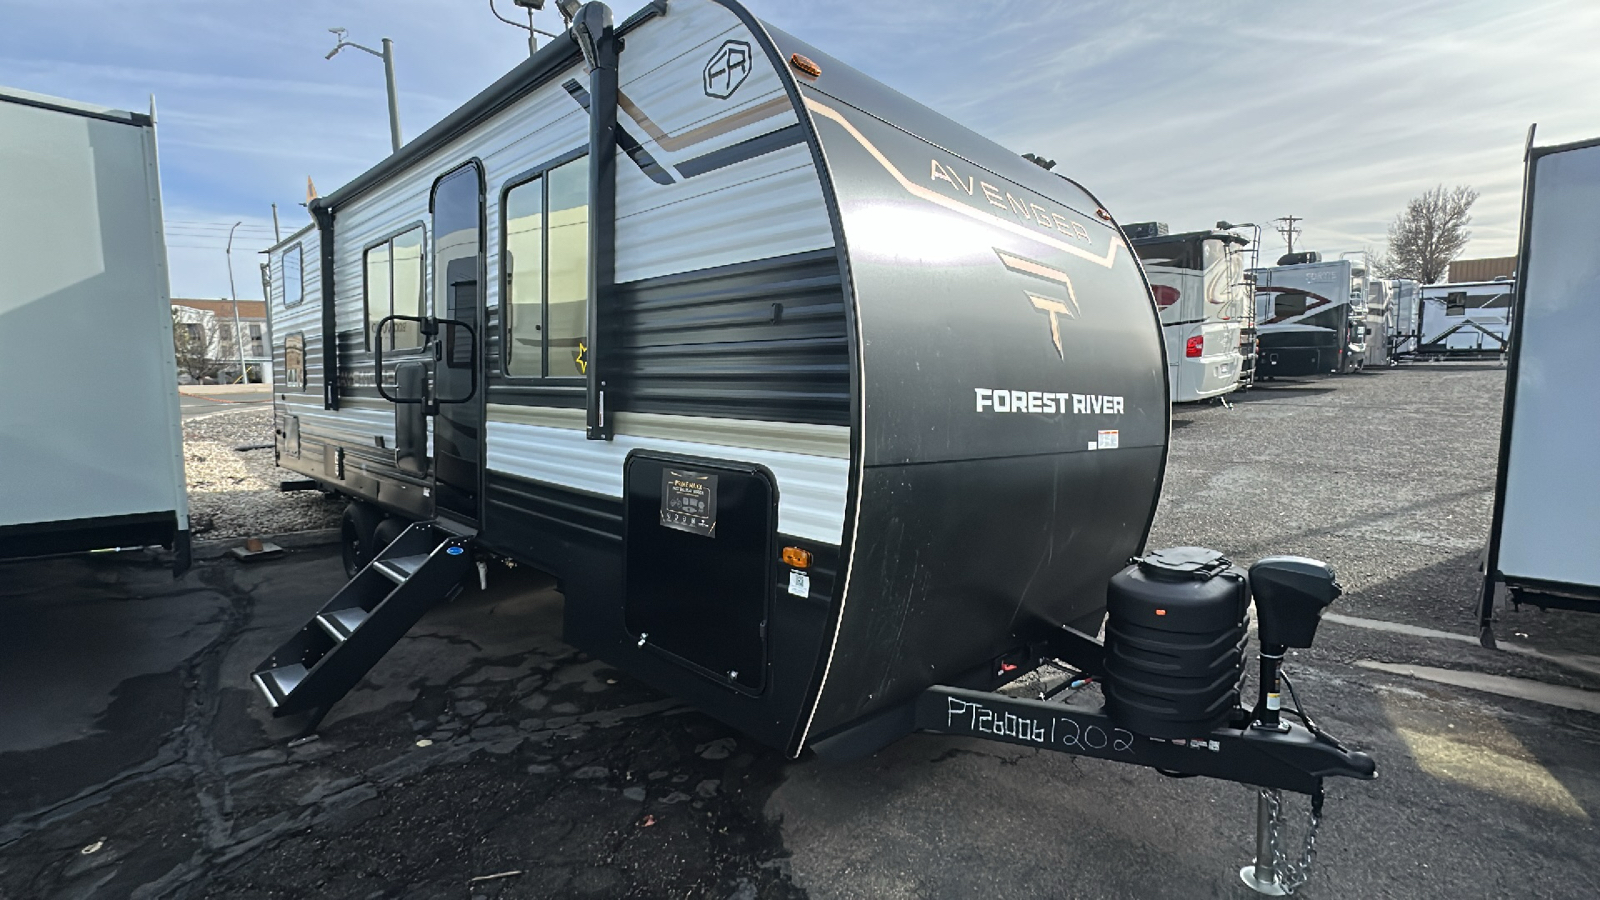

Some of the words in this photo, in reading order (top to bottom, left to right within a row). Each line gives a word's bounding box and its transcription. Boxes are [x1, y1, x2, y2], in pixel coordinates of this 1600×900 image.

[930, 159, 1092, 245] AVENGER
[974, 388, 1069, 413] FOREST
[1072, 394, 1125, 414] RIVER
